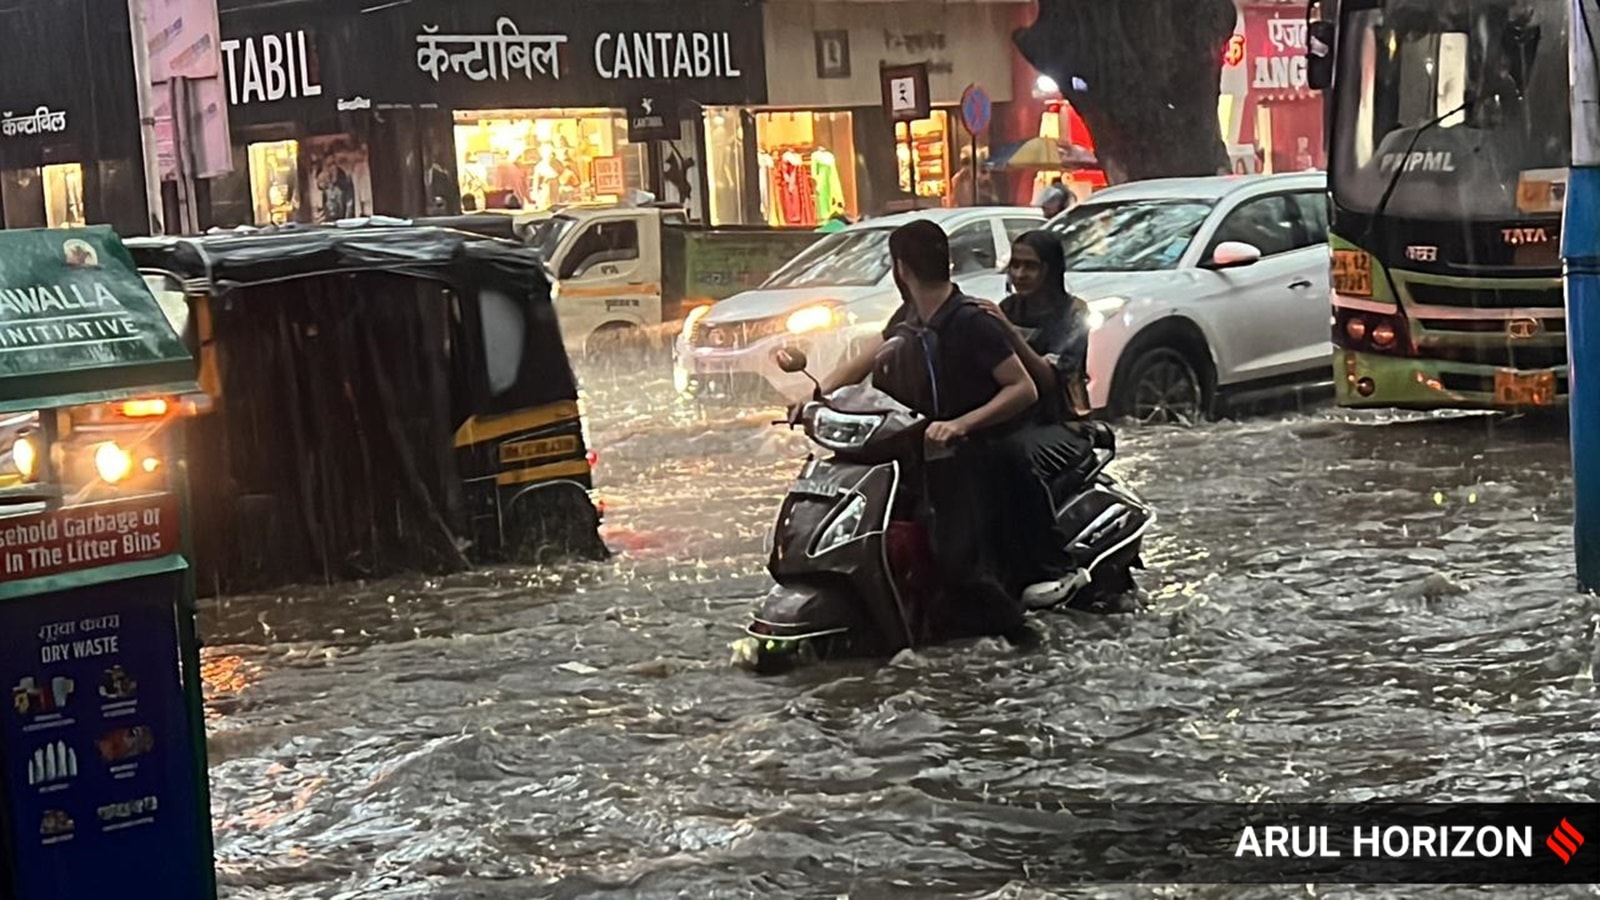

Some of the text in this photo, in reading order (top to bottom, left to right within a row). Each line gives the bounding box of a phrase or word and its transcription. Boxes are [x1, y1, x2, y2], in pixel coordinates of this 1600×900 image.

[221, 30, 321, 104] TABIL
[416, 17, 567, 81] कॅन्टाबिल
[594, 32, 740, 79] CANTABIL
[1501, 228, 1547, 244] TATA
[65, 512, 138, 534] Garbage
[143, 508, 160, 527] or
[5, 531, 161, 573] In The Litter Bins
[41, 636, 118, 664] DRY WASTE
